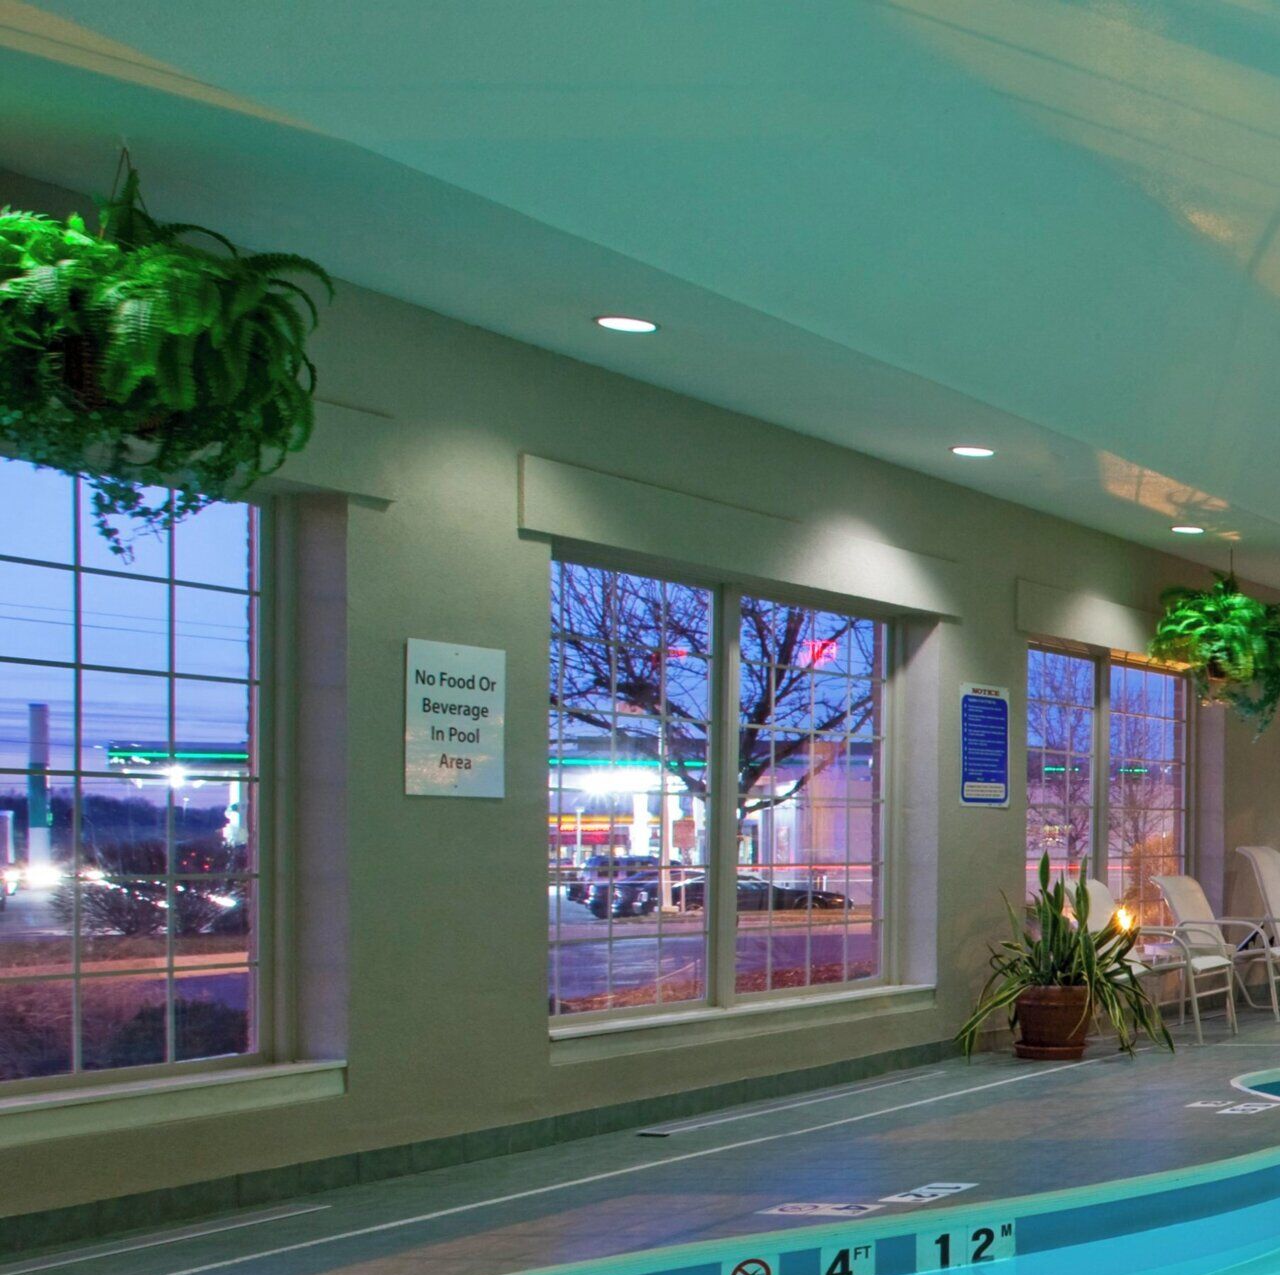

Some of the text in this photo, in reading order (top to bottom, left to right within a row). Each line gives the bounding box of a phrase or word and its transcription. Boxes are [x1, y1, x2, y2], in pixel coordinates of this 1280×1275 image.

[415, 669, 496, 692] No Food Or
[422, 697, 489, 720] Beverage
[432, 726, 480, 743] In Pool
[439, 753, 472, 770] Area
[854, 1245, 872, 1260] FT
